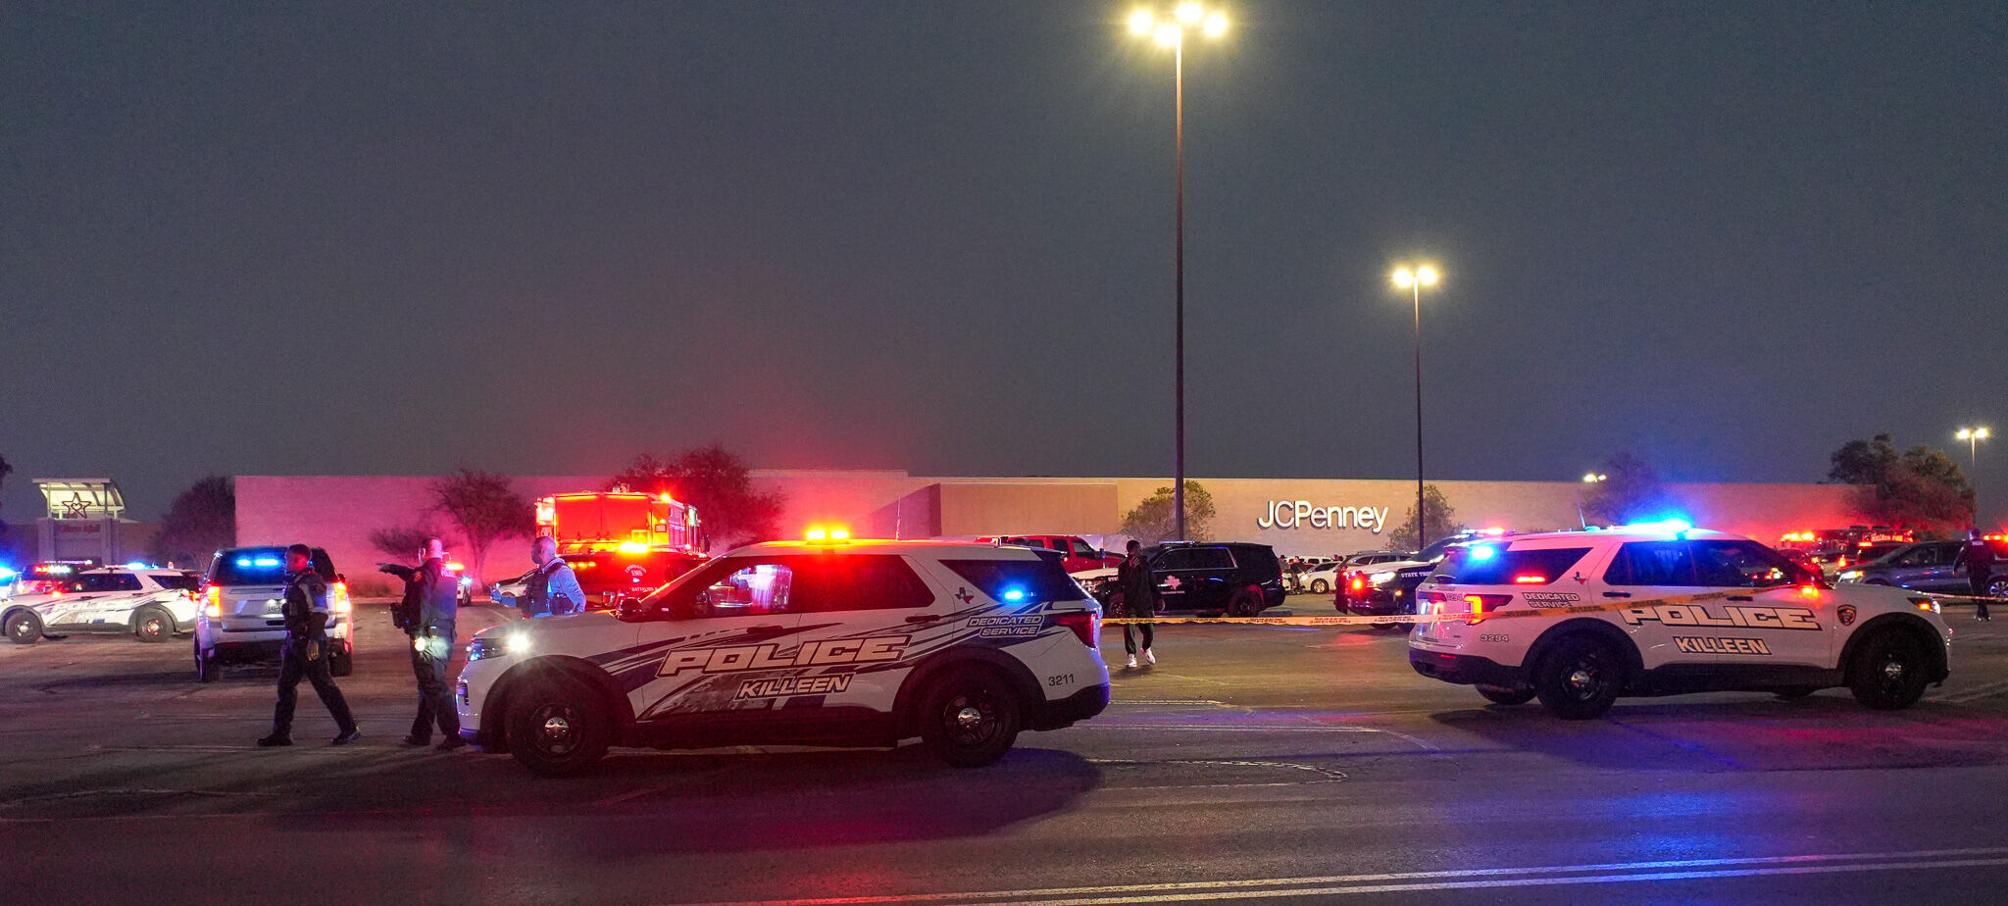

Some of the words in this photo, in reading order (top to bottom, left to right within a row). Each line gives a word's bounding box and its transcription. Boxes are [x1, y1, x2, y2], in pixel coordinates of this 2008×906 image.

[1257, 500, 1389, 534] JCPenney
[1523, 592, 1579, 601] DEDICATED
[969, 616, 1043, 627] DEDICATED
[1617, 604, 1821, 630] POLICE
[981, 627, 1038, 636] SERVICE
[1674, 636, 1771, 654] KILLEEN
[657, 636, 910, 676] POLICE
[736, 675, 852, 700] KILLEEN
[1048, 674, 1074, 686] 3211
